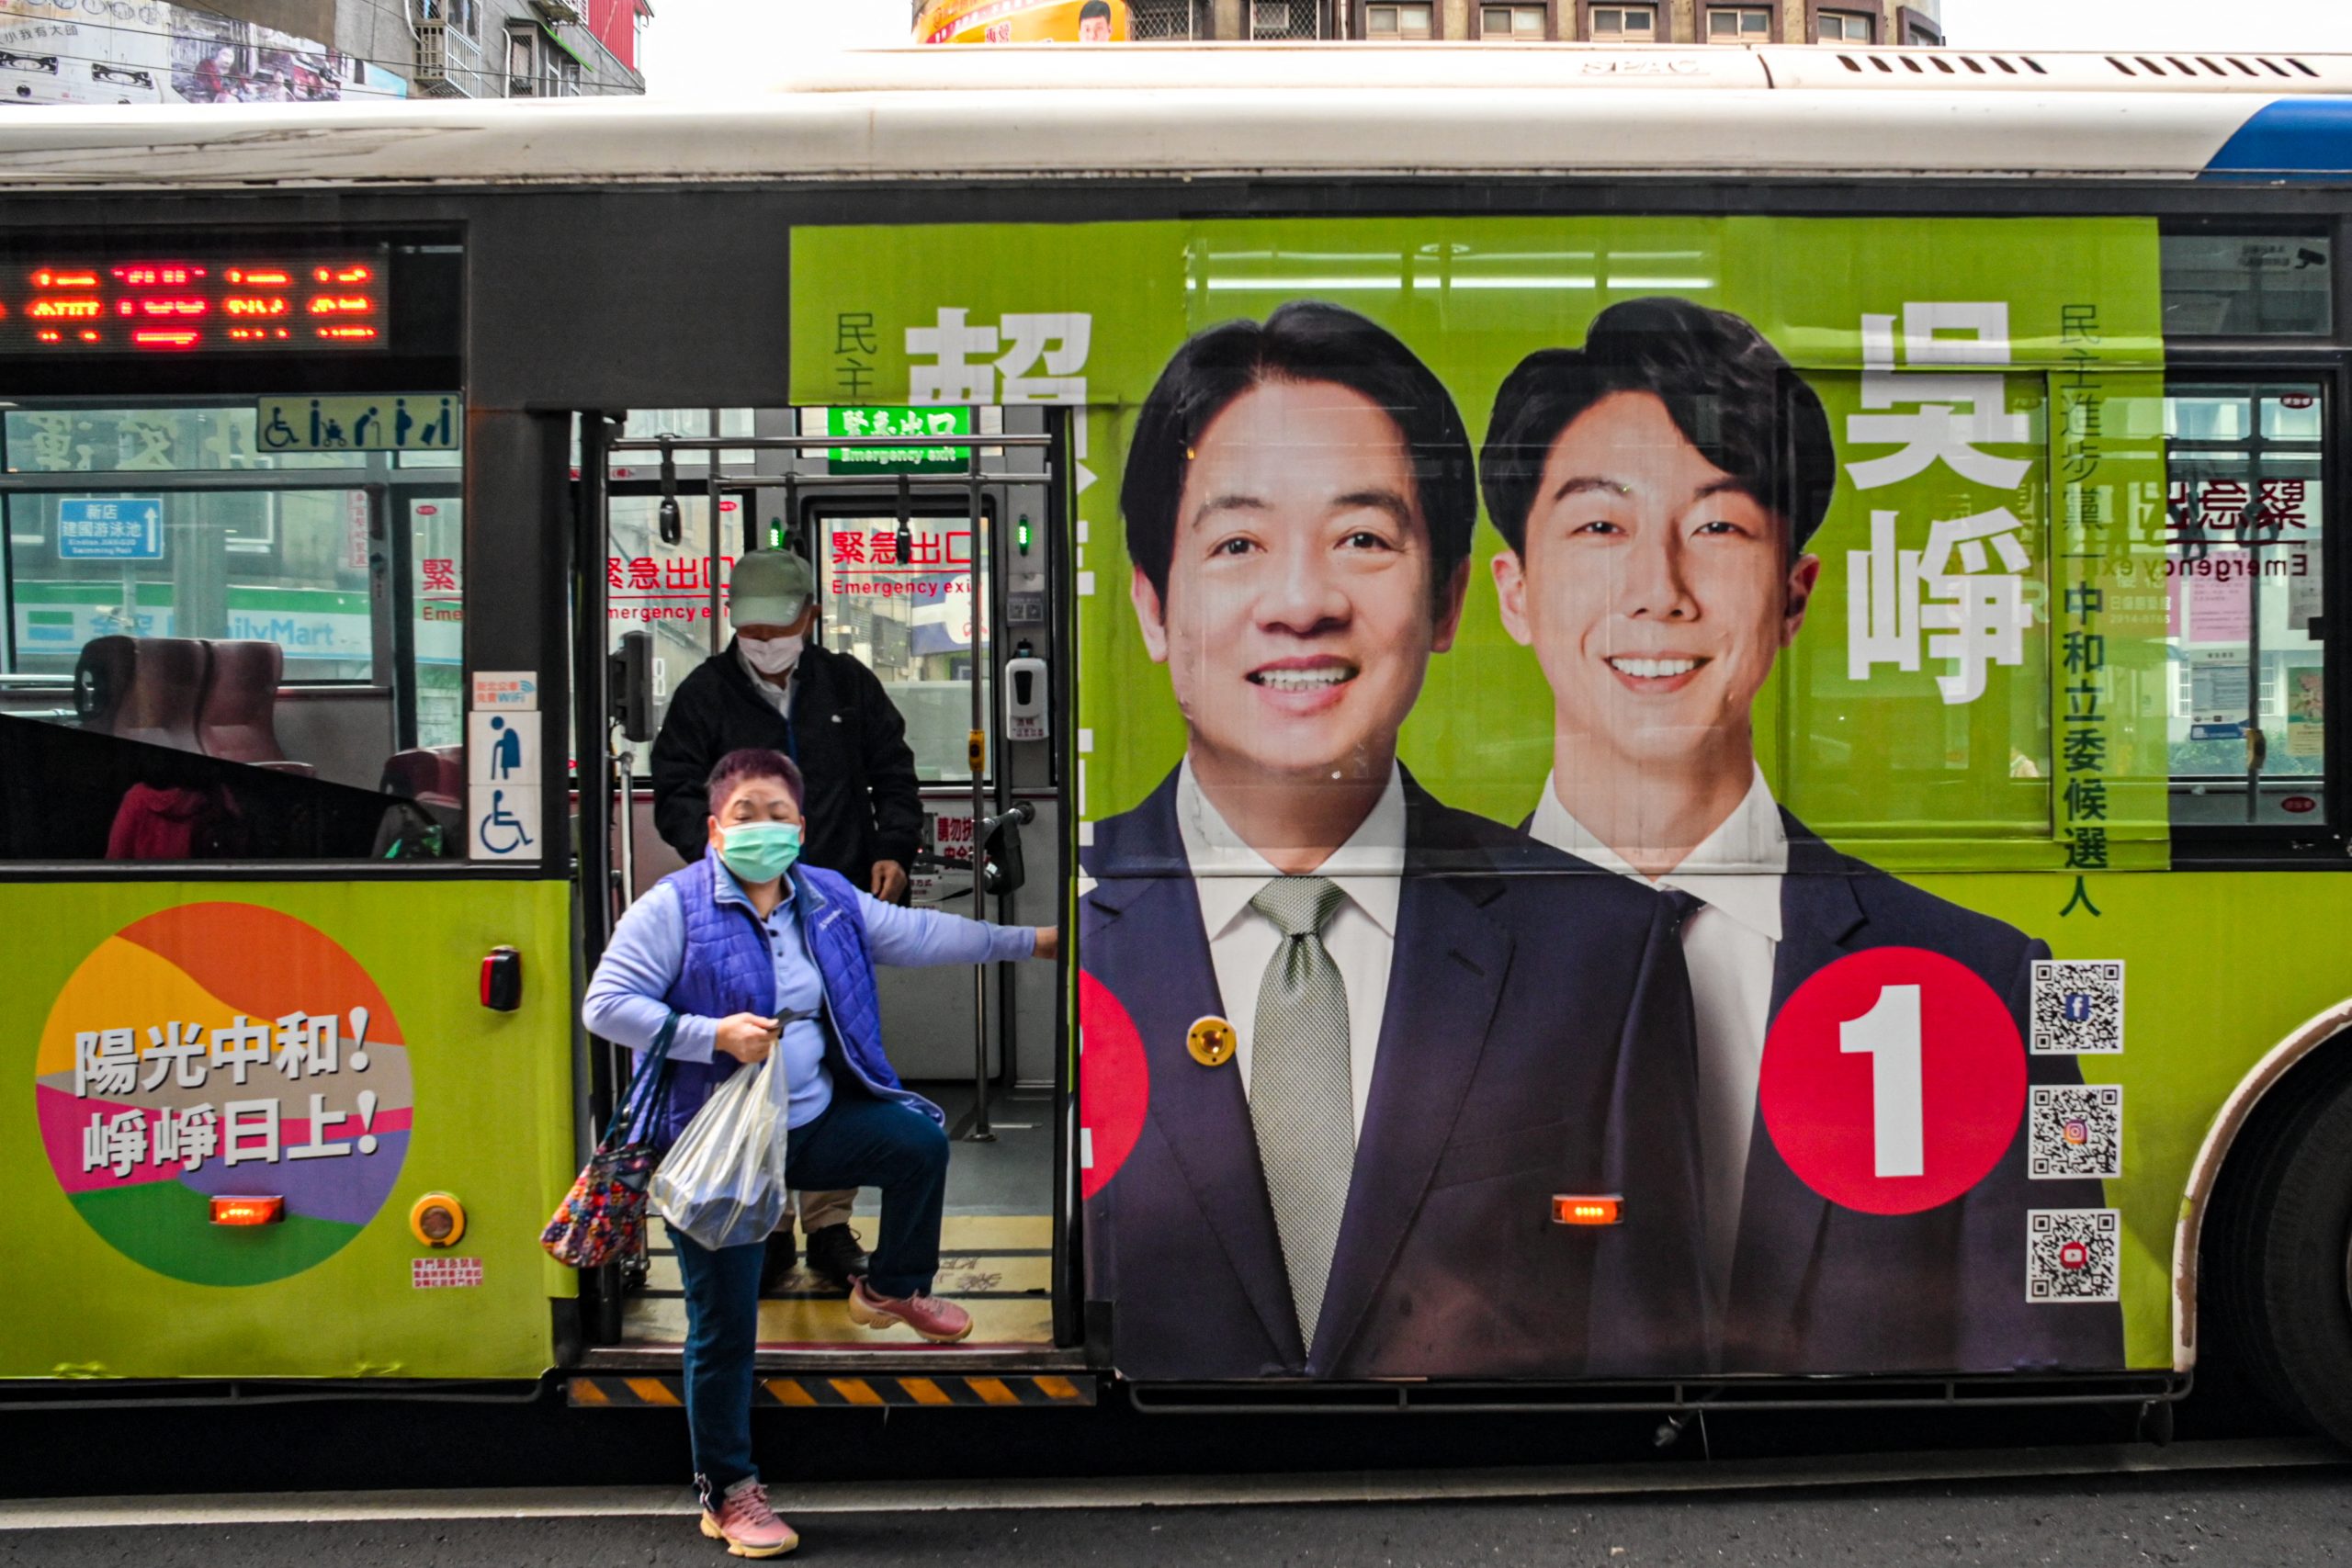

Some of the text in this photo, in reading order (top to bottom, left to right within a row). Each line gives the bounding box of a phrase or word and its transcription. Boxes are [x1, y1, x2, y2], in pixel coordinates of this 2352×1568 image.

[0, 25, 78, 44] 小我有大頭
[832, 531, 971, 564] 緊急出口
[1844, 301, 2033, 705] 吳崢
[608, 606, 696, 623] mergency
[832, 579, 972, 597] Emergency exi
[2059, 581, 2109, 919] 中和立委候選人
[74, 1006, 370, 1097] 陽光中和!
[1839, 984, 1924, 1178] 1
[83, 1089, 379, 1178] 崢崢日上!
